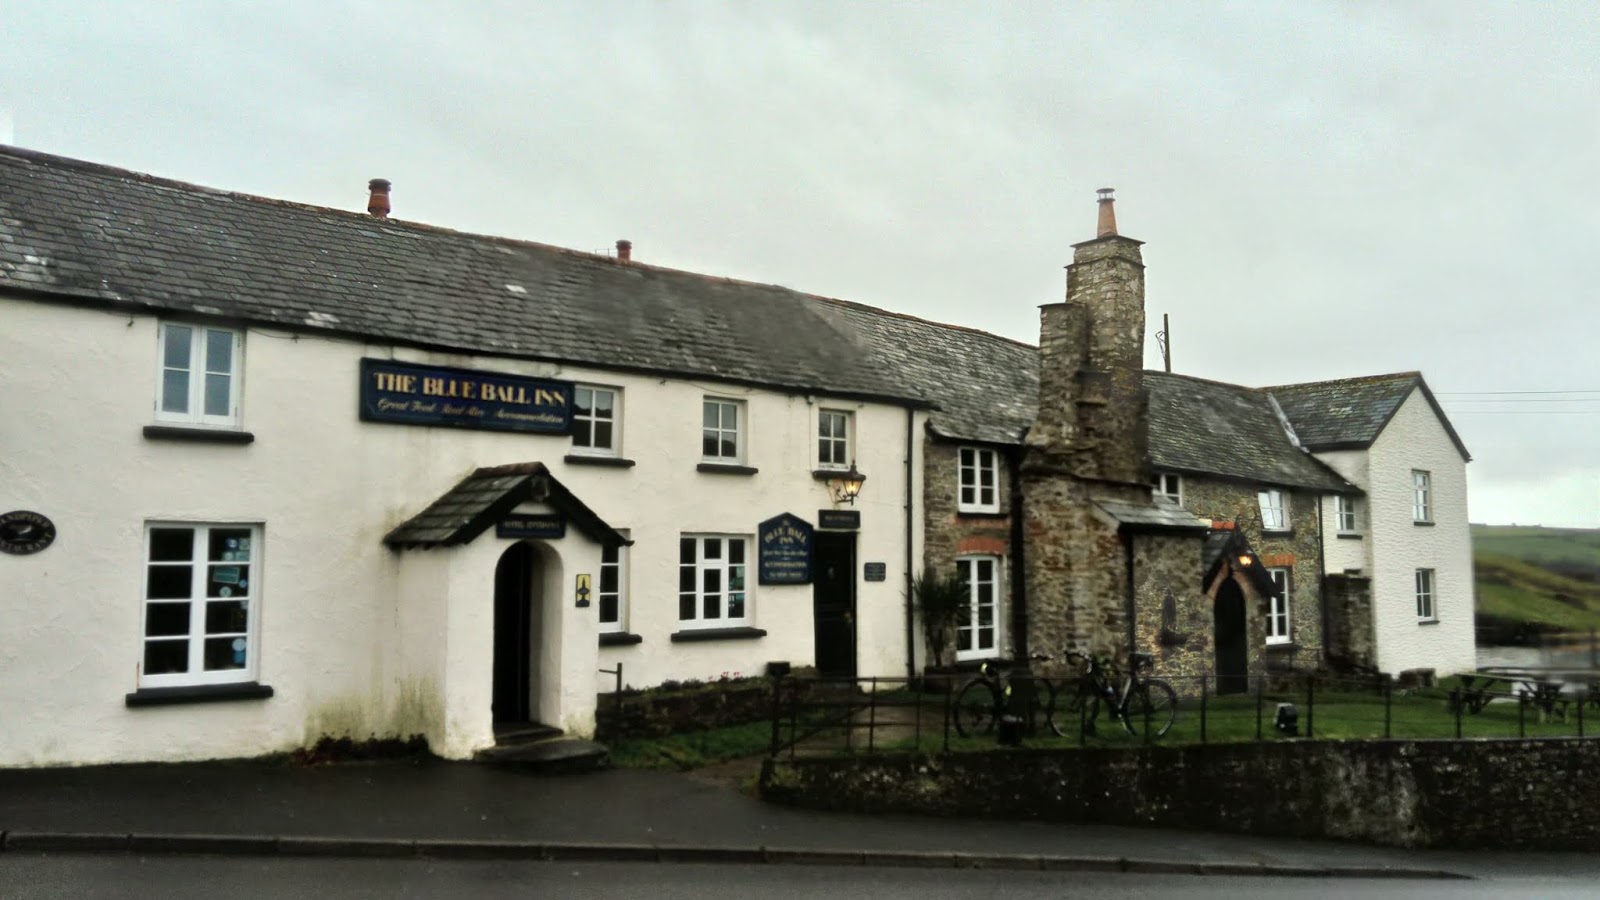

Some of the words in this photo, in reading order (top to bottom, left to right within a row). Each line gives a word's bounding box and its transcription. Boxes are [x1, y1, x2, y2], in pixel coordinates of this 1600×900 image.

[373, 372, 417, 394] THE
[423, 377, 476, 399] BLUE
[481, 383, 531, 404] BALL
[535, 388, 566, 407] INN
[377, 398, 410, 411] Great
